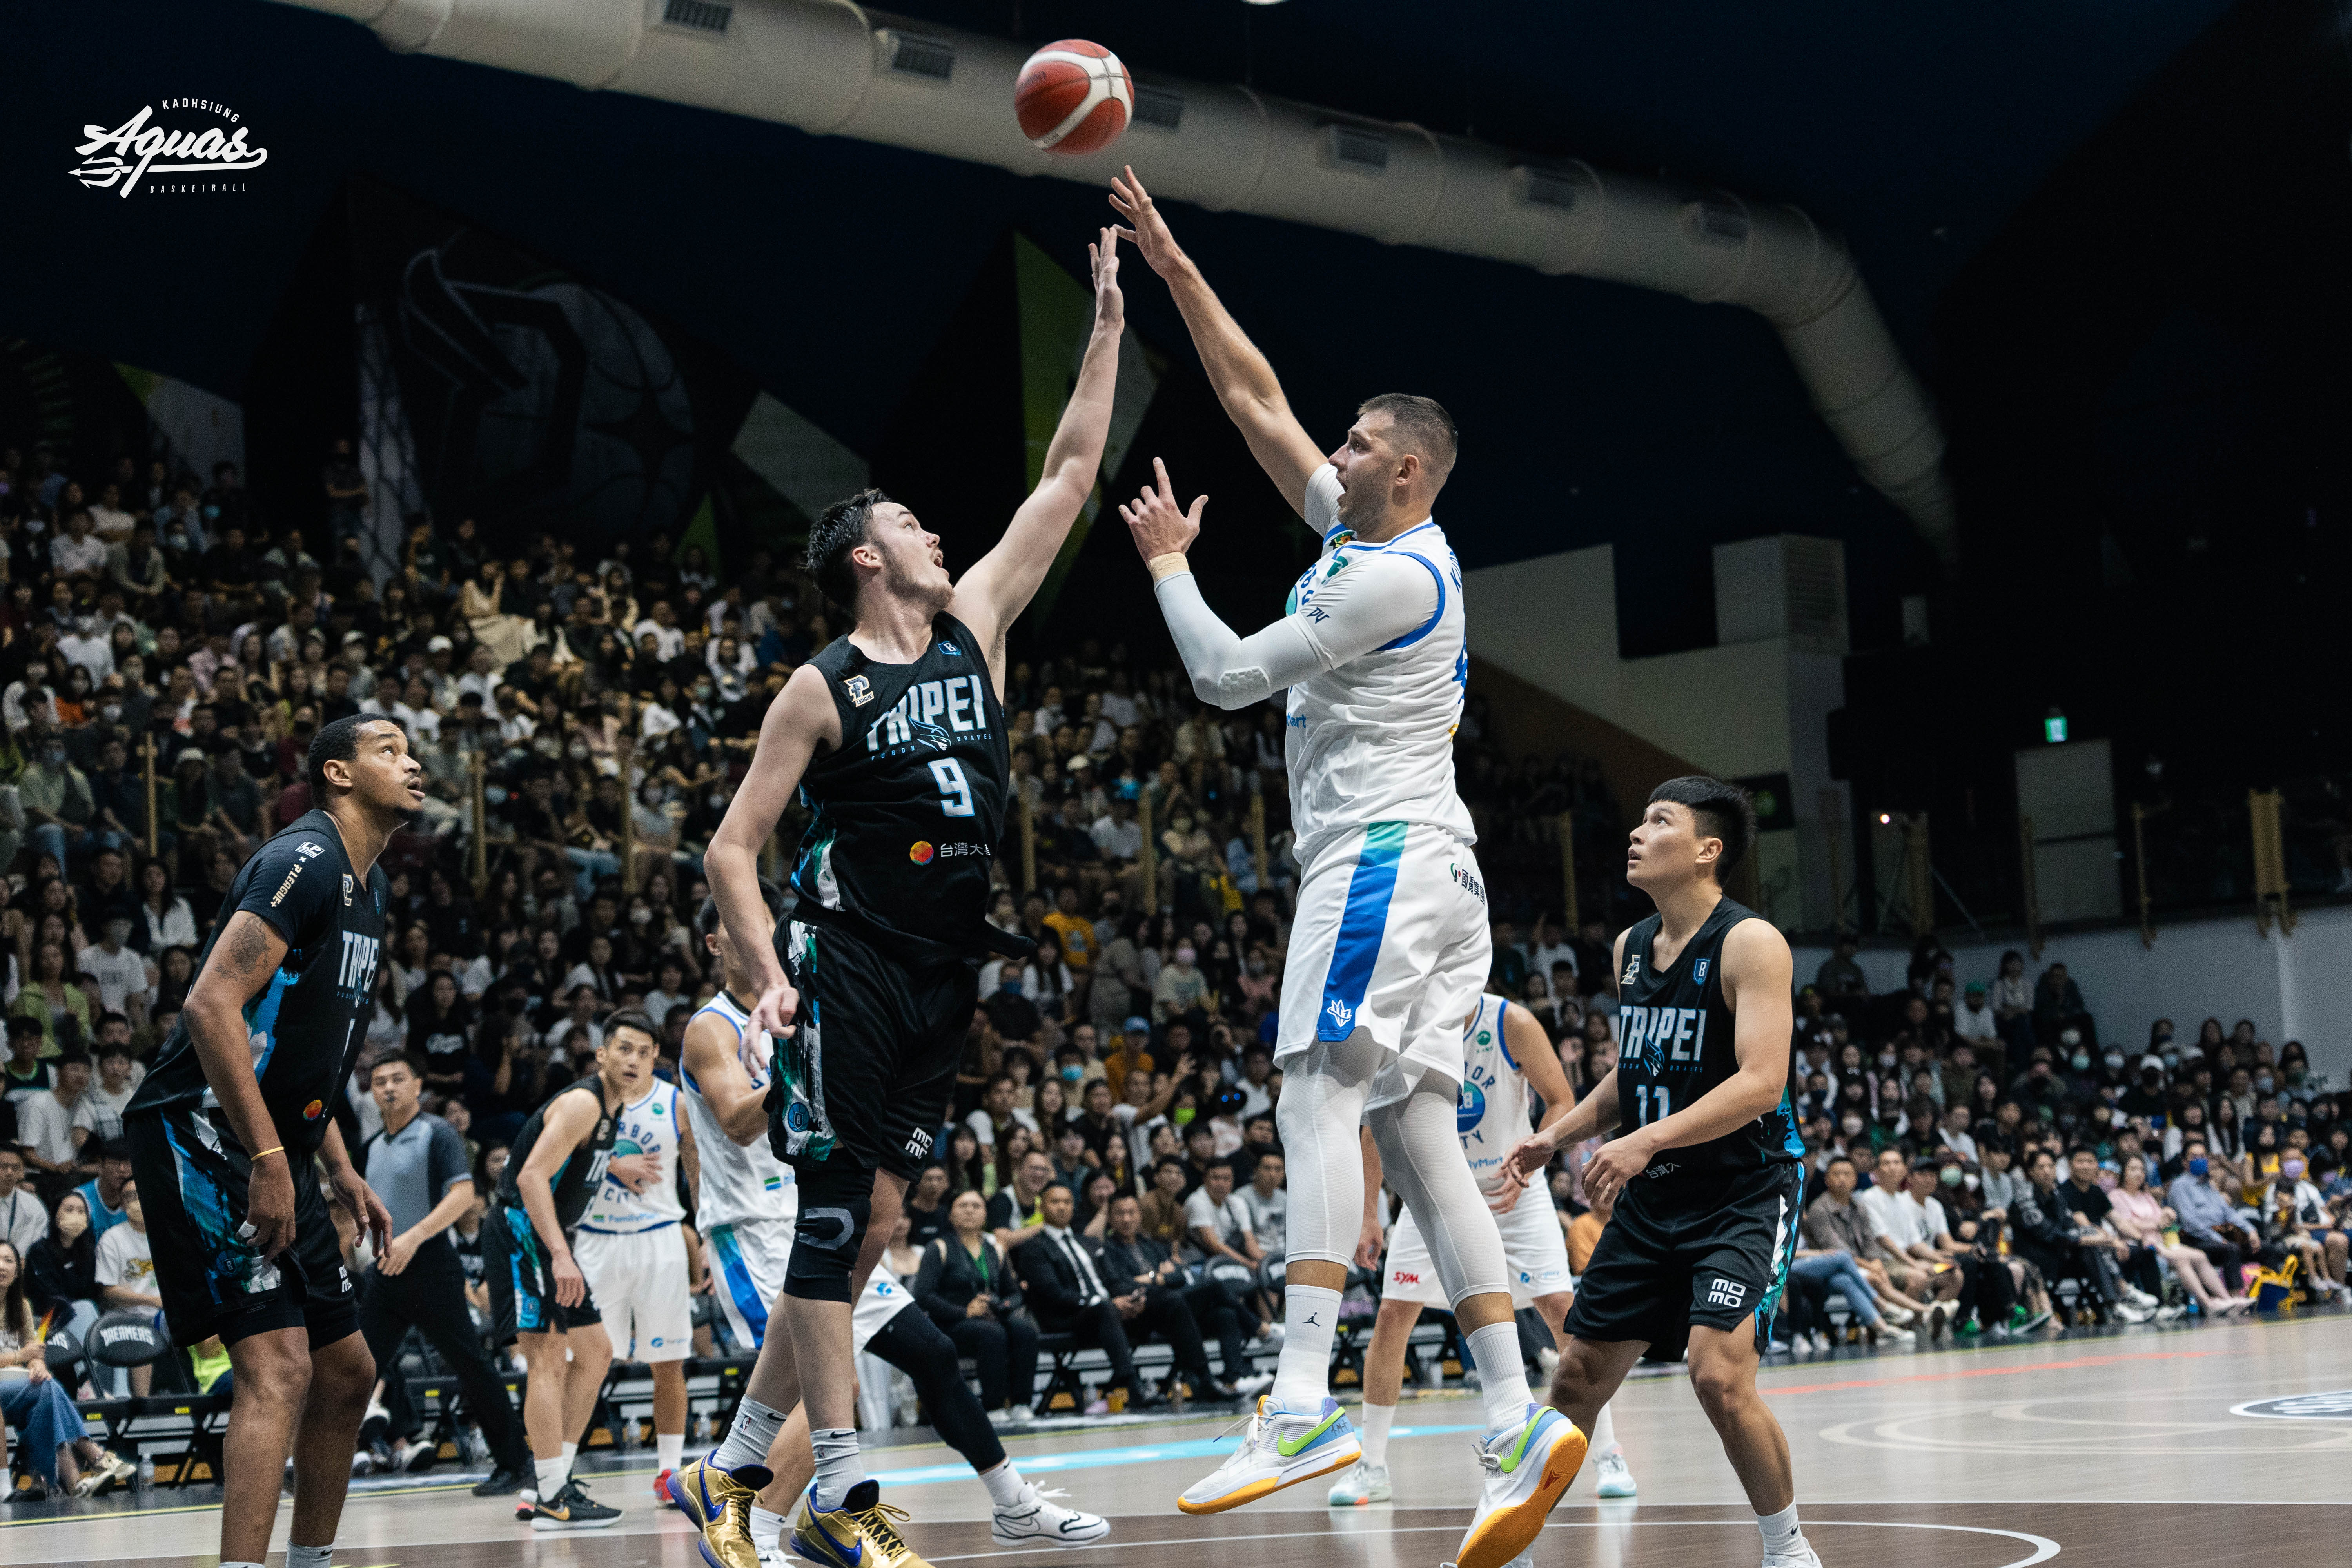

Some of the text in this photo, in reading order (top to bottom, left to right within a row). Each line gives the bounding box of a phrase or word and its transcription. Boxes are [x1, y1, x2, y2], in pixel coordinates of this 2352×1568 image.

[857, 694, 872, 705] LEAGUE
[867, 675, 987, 752] TAIPEI
[871, 744, 915, 761] FUBON
[928, 757, 975, 817] 9
[301, 842, 322, 852] LP
[1619, 1005, 1707, 1062] TAIPEI
[1635, 1085, 1670, 1127] 11
[1392, 1271, 1421, 1285] SYM
